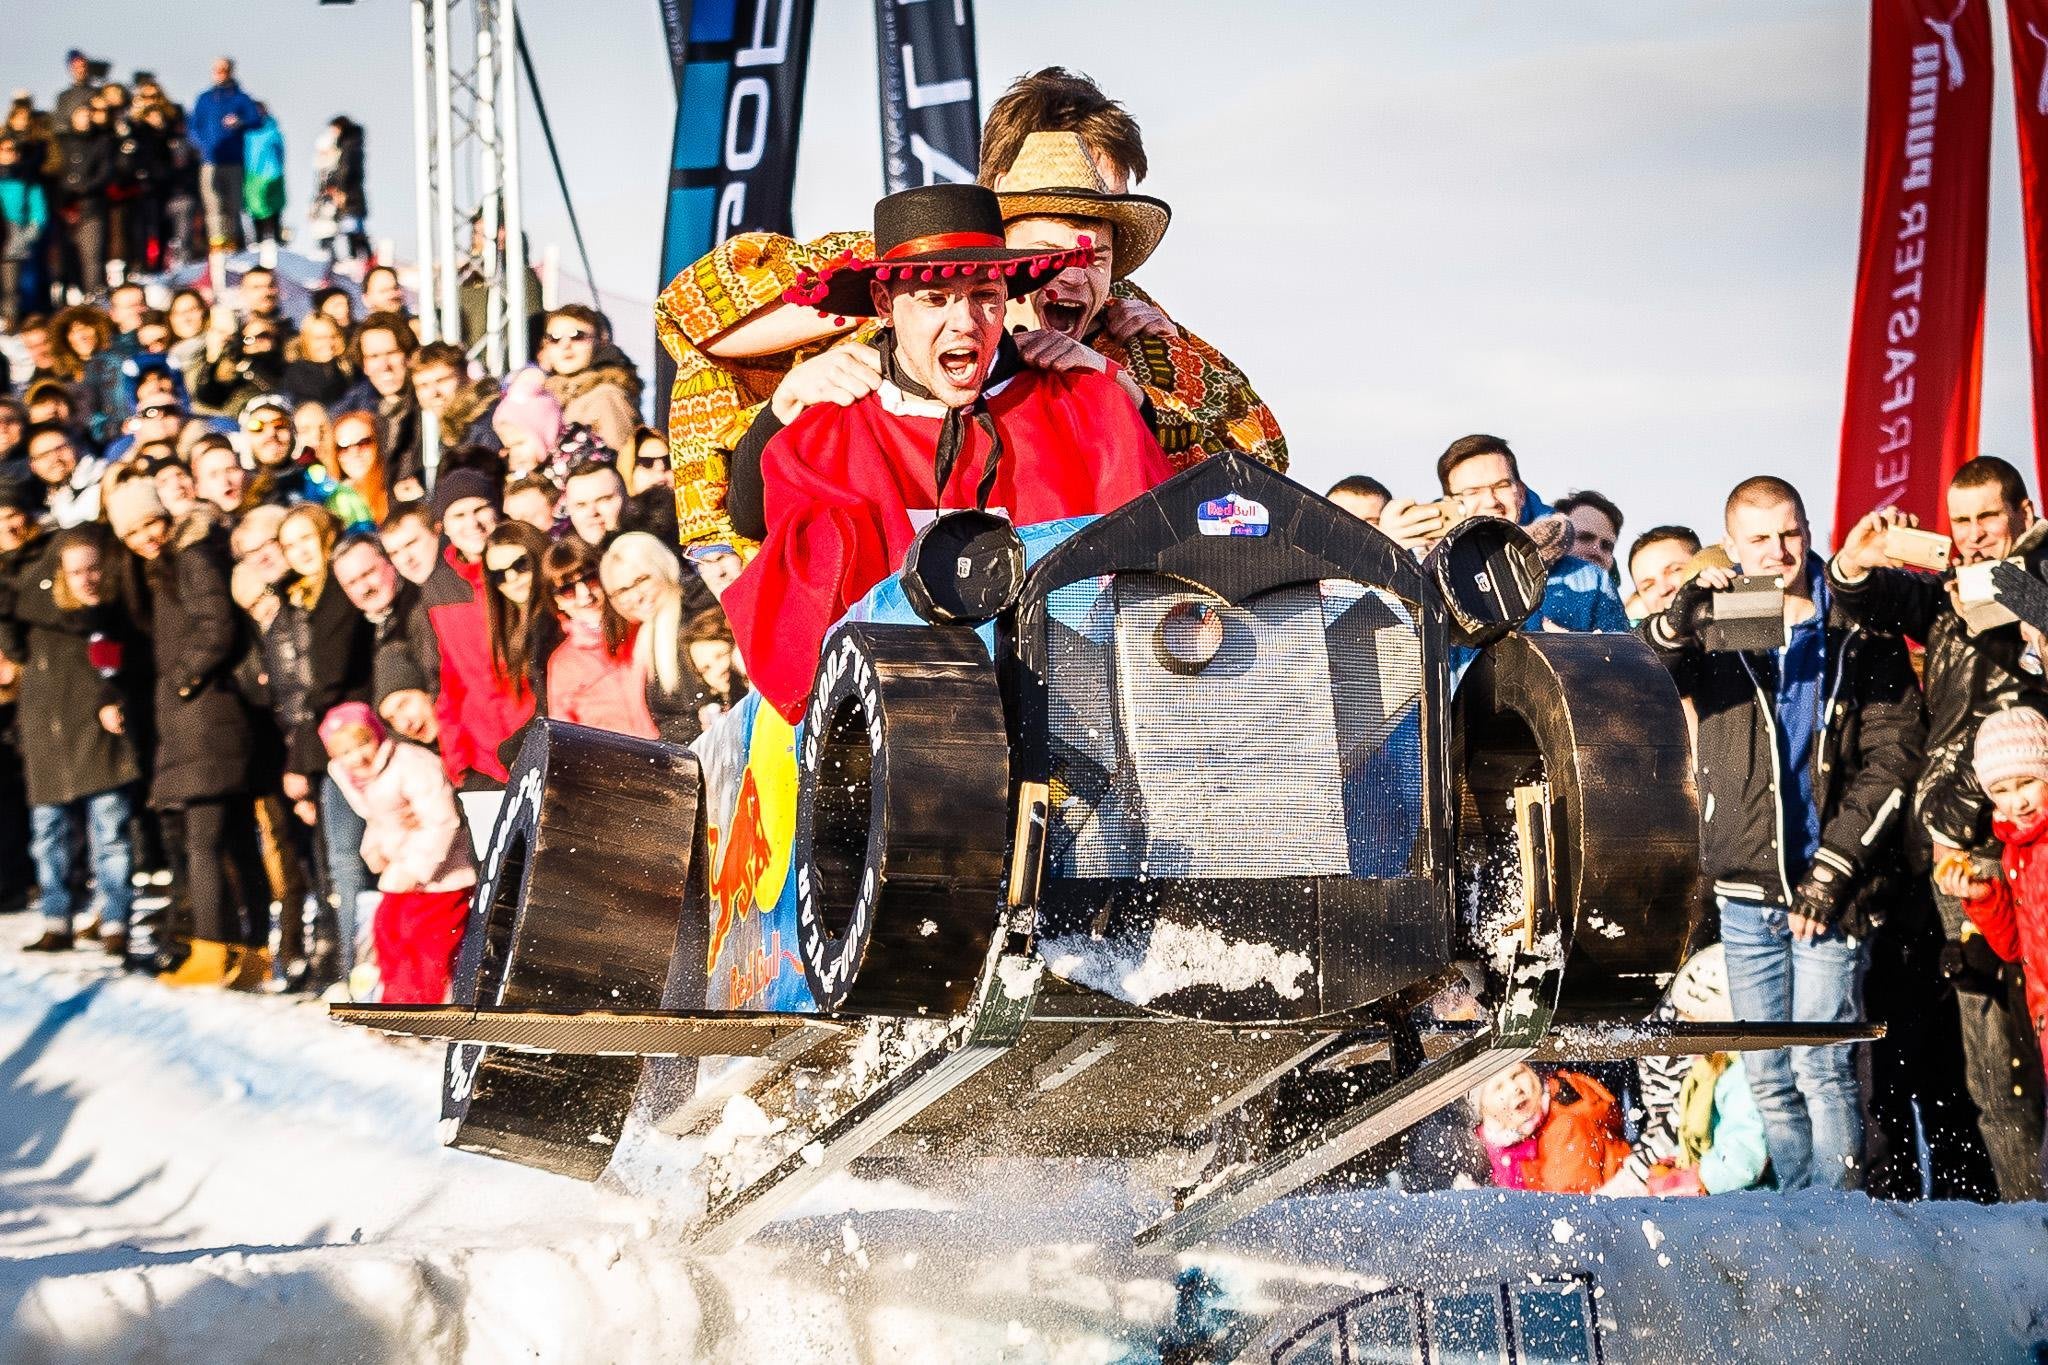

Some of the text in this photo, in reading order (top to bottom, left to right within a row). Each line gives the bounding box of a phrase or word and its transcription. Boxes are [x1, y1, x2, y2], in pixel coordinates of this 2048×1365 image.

[1206, 502, 1257, 517] Red Bull
[729, 930, 780, 1010] Red Bull
